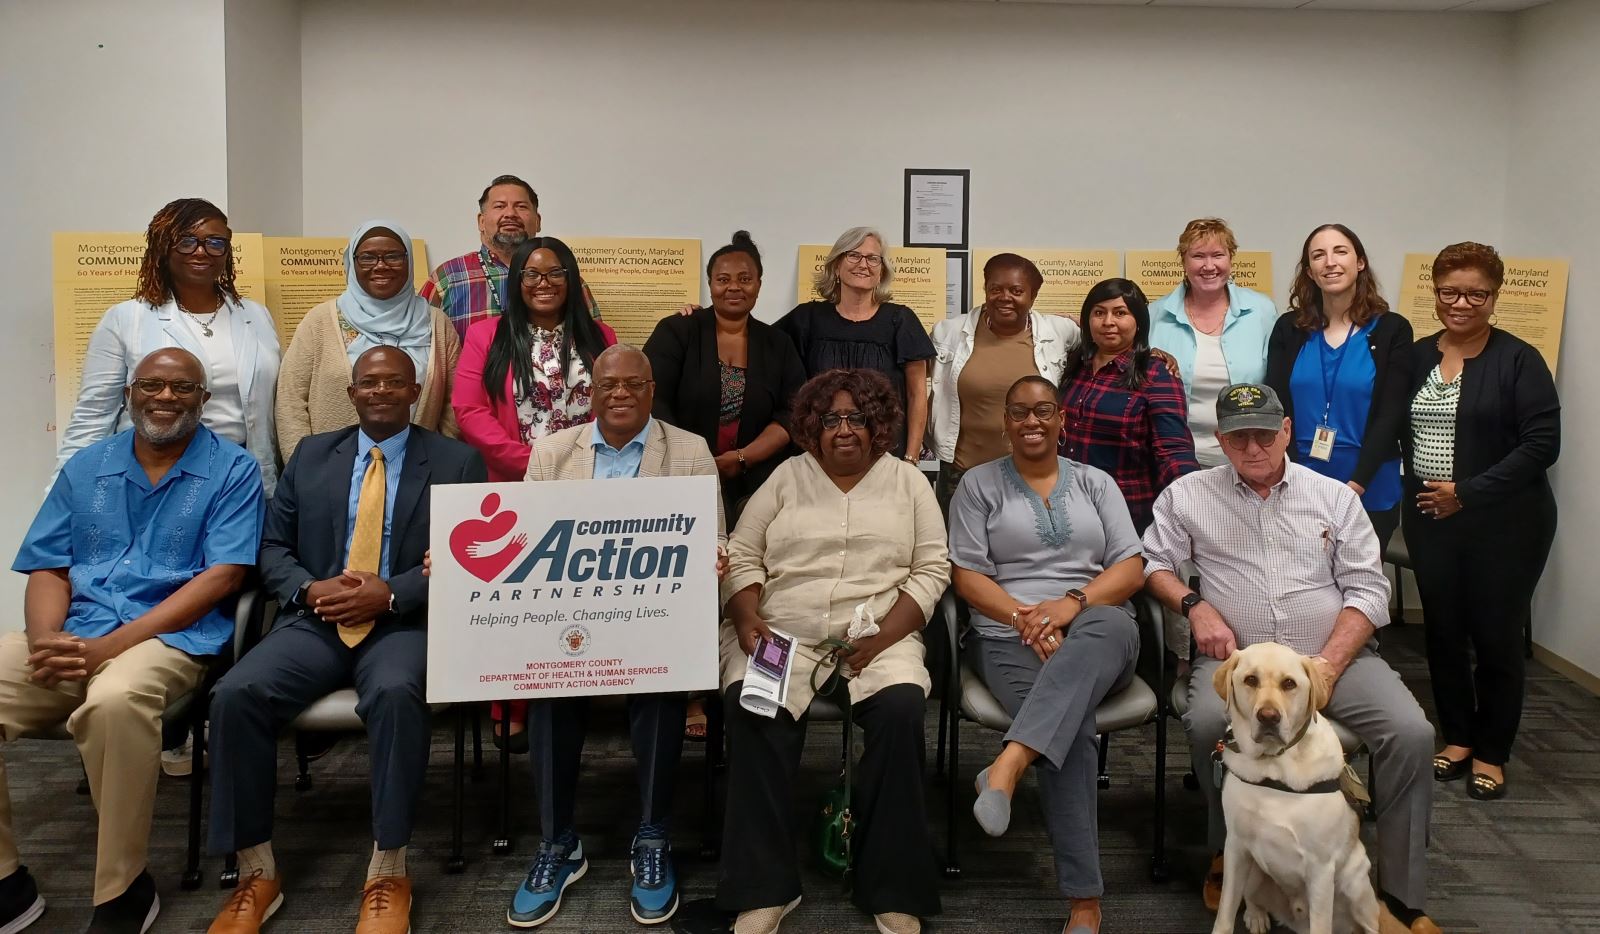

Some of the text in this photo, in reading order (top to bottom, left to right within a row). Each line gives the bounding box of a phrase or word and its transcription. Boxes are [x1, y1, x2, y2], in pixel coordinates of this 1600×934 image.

[280, 247, 336, 257] Montgomery
[573, 247, 684, 257] ontgomery County, Maryland
[78, 256, 146, 266] COMMUNIT
[281, 258, 340, 266] COMMUNITY
[577, 256, 685, 266] MMUNITY ACTION AGENCY
[895, 256, 931, 265] Maryland
[1039, 259, 1068, 268] County,
[1069, 259, 1104, 268] Maryland
[1141, 260, 1183, 269] Montgome
[1232, 261, 1256, 269] ryland
[90, 269, 113, 277] Years
[596, 267, 619, 275] Helping
[899, 266, 931, 274] AGENCY
[1072, 269, 1104, 277] AGENCY
[1508, 267, 1549, 278] Maryland
[1510, 279, 1548, 288] AGENCY
[576, 513, 697, 536] community
[502, 519, 689, 584] Action
[469, 582, 682, 603] PARTNERSHIP
[469, 606, 670, 627] Helping People. Changing Lives.
[526, 658, 623, 670] MONTGOMERY COUNTY
[479, 666, 669, 683] DEPARTMENT OF HEALTH & HUMAN SERVICES
[513, 678, 635, 691] COMMUNITY ACTION AGENCY
